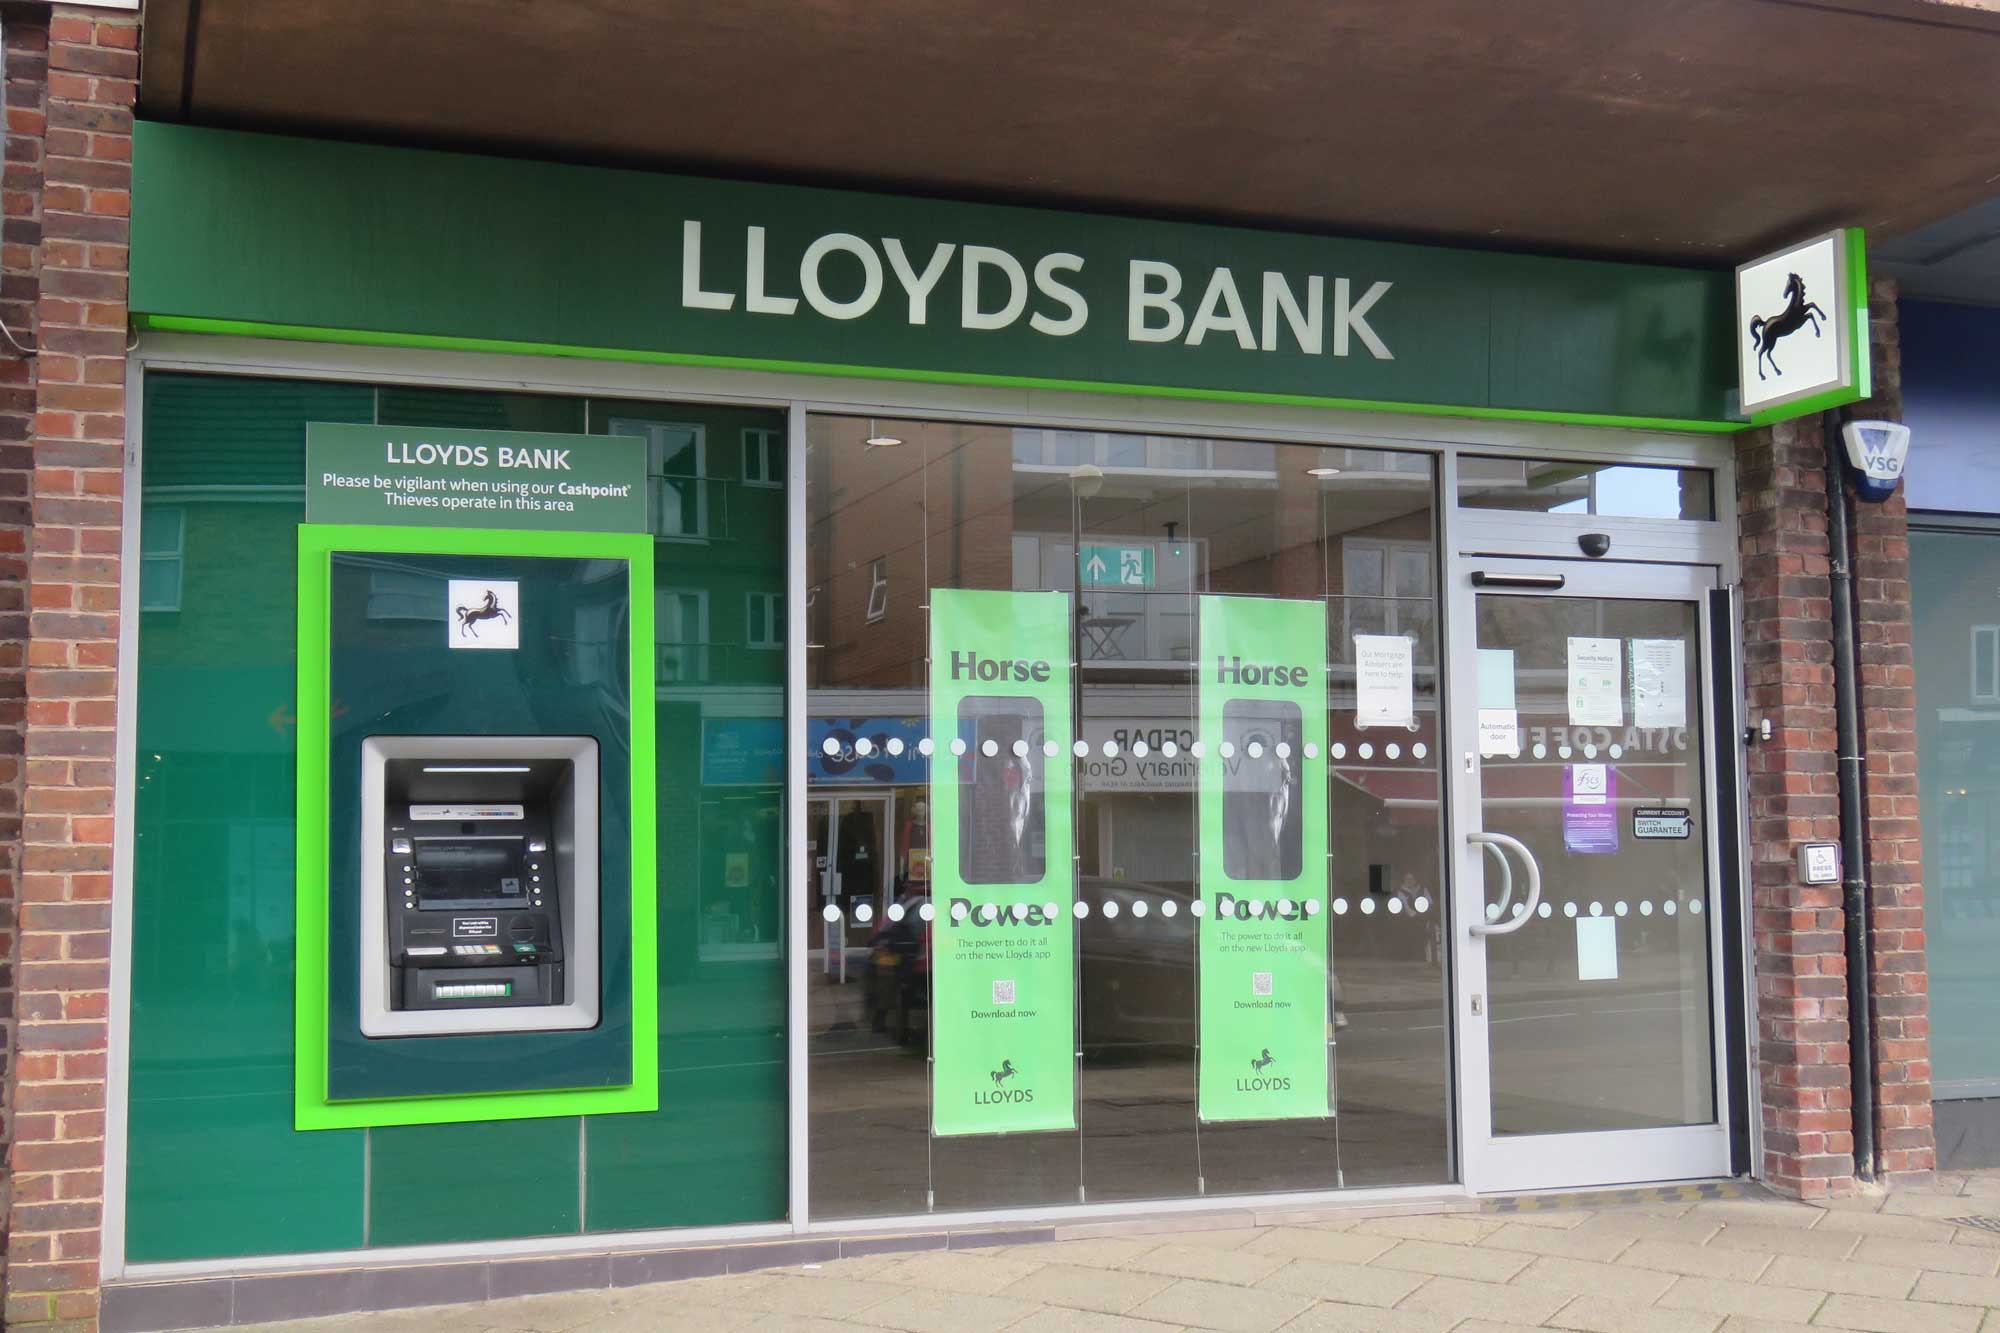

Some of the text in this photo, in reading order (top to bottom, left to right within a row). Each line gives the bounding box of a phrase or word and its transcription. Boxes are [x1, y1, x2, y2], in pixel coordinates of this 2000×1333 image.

[682, 220, 1395, 360] LLOYDS BANK
[387, 442, 571, 470] LLOYDS BANK
[1864, 456, 1898, 472] VSG
[323, 473, 370, 488] Please
[373, 475, 392, 489] be
[394, 476, 447, 493] vigilant
[450, 478, 489, 492] when
[492, 480, 528, 496] using
[531, 484, 555, 495] our
[384, 492, 574, 512] Thieves operate in this area
[1361, 650, 1406, 660] Our Mortgage
[950, 651, 1050, 682] Horse
[1217, 655, 1309, 688] Horse
[1490, 732, 1506, 740] door
[1215, 891, 1314, 922] Power
[958, 936, 1048, 950] The power to do it all
[1221, 931, 1303, 943] The power to do it all
[955, 949, 1051, 961] on the new Lloyds app
[1219, 943, 1306, 954] on the new Lloyds app
[1233, 1000, 1292, 1010] Download now
[970, 1009, 1037, 1020] Download now
[1236, 1077, 1291, 1092] LLOYDS
[974, 1089, 1034, 1105] LLOYDS
